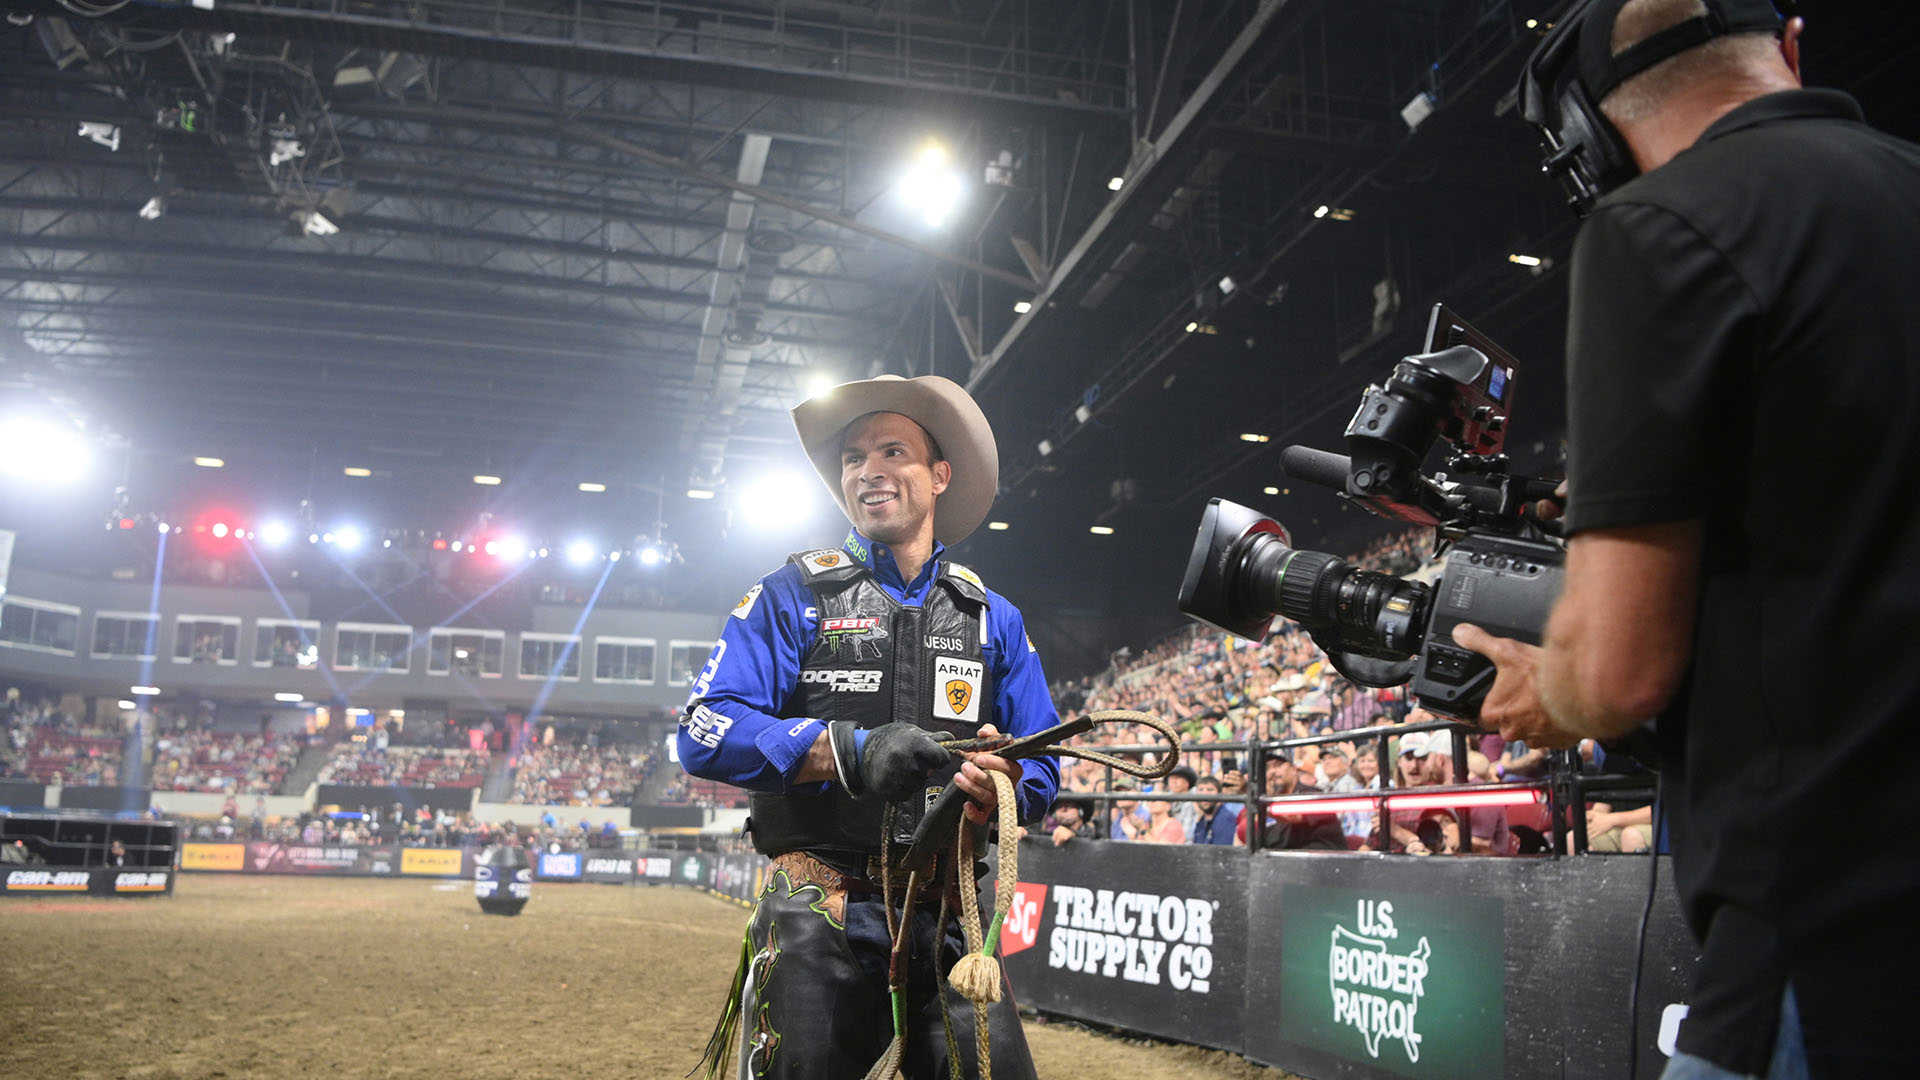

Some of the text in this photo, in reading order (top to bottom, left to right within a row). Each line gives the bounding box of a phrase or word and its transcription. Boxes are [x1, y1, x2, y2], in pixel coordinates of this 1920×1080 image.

[824, 618, 876, 630] PBR
[925, 635, 963, 651] JESUS
[830, 682, 880, 692] TIRES
[938, 664, 981, 678] ARIAT
[1003, 891, 1037, 945] SC
[1053, 885, 1213, 945] TRACTOR
[1357, 899, 1398, 938] U.S.
[1049, 926, 1166, 985] SUPPLY
[1333, 945, 1428, 997] BORDER
[1333, 987, 1422, 1044] PATROL
